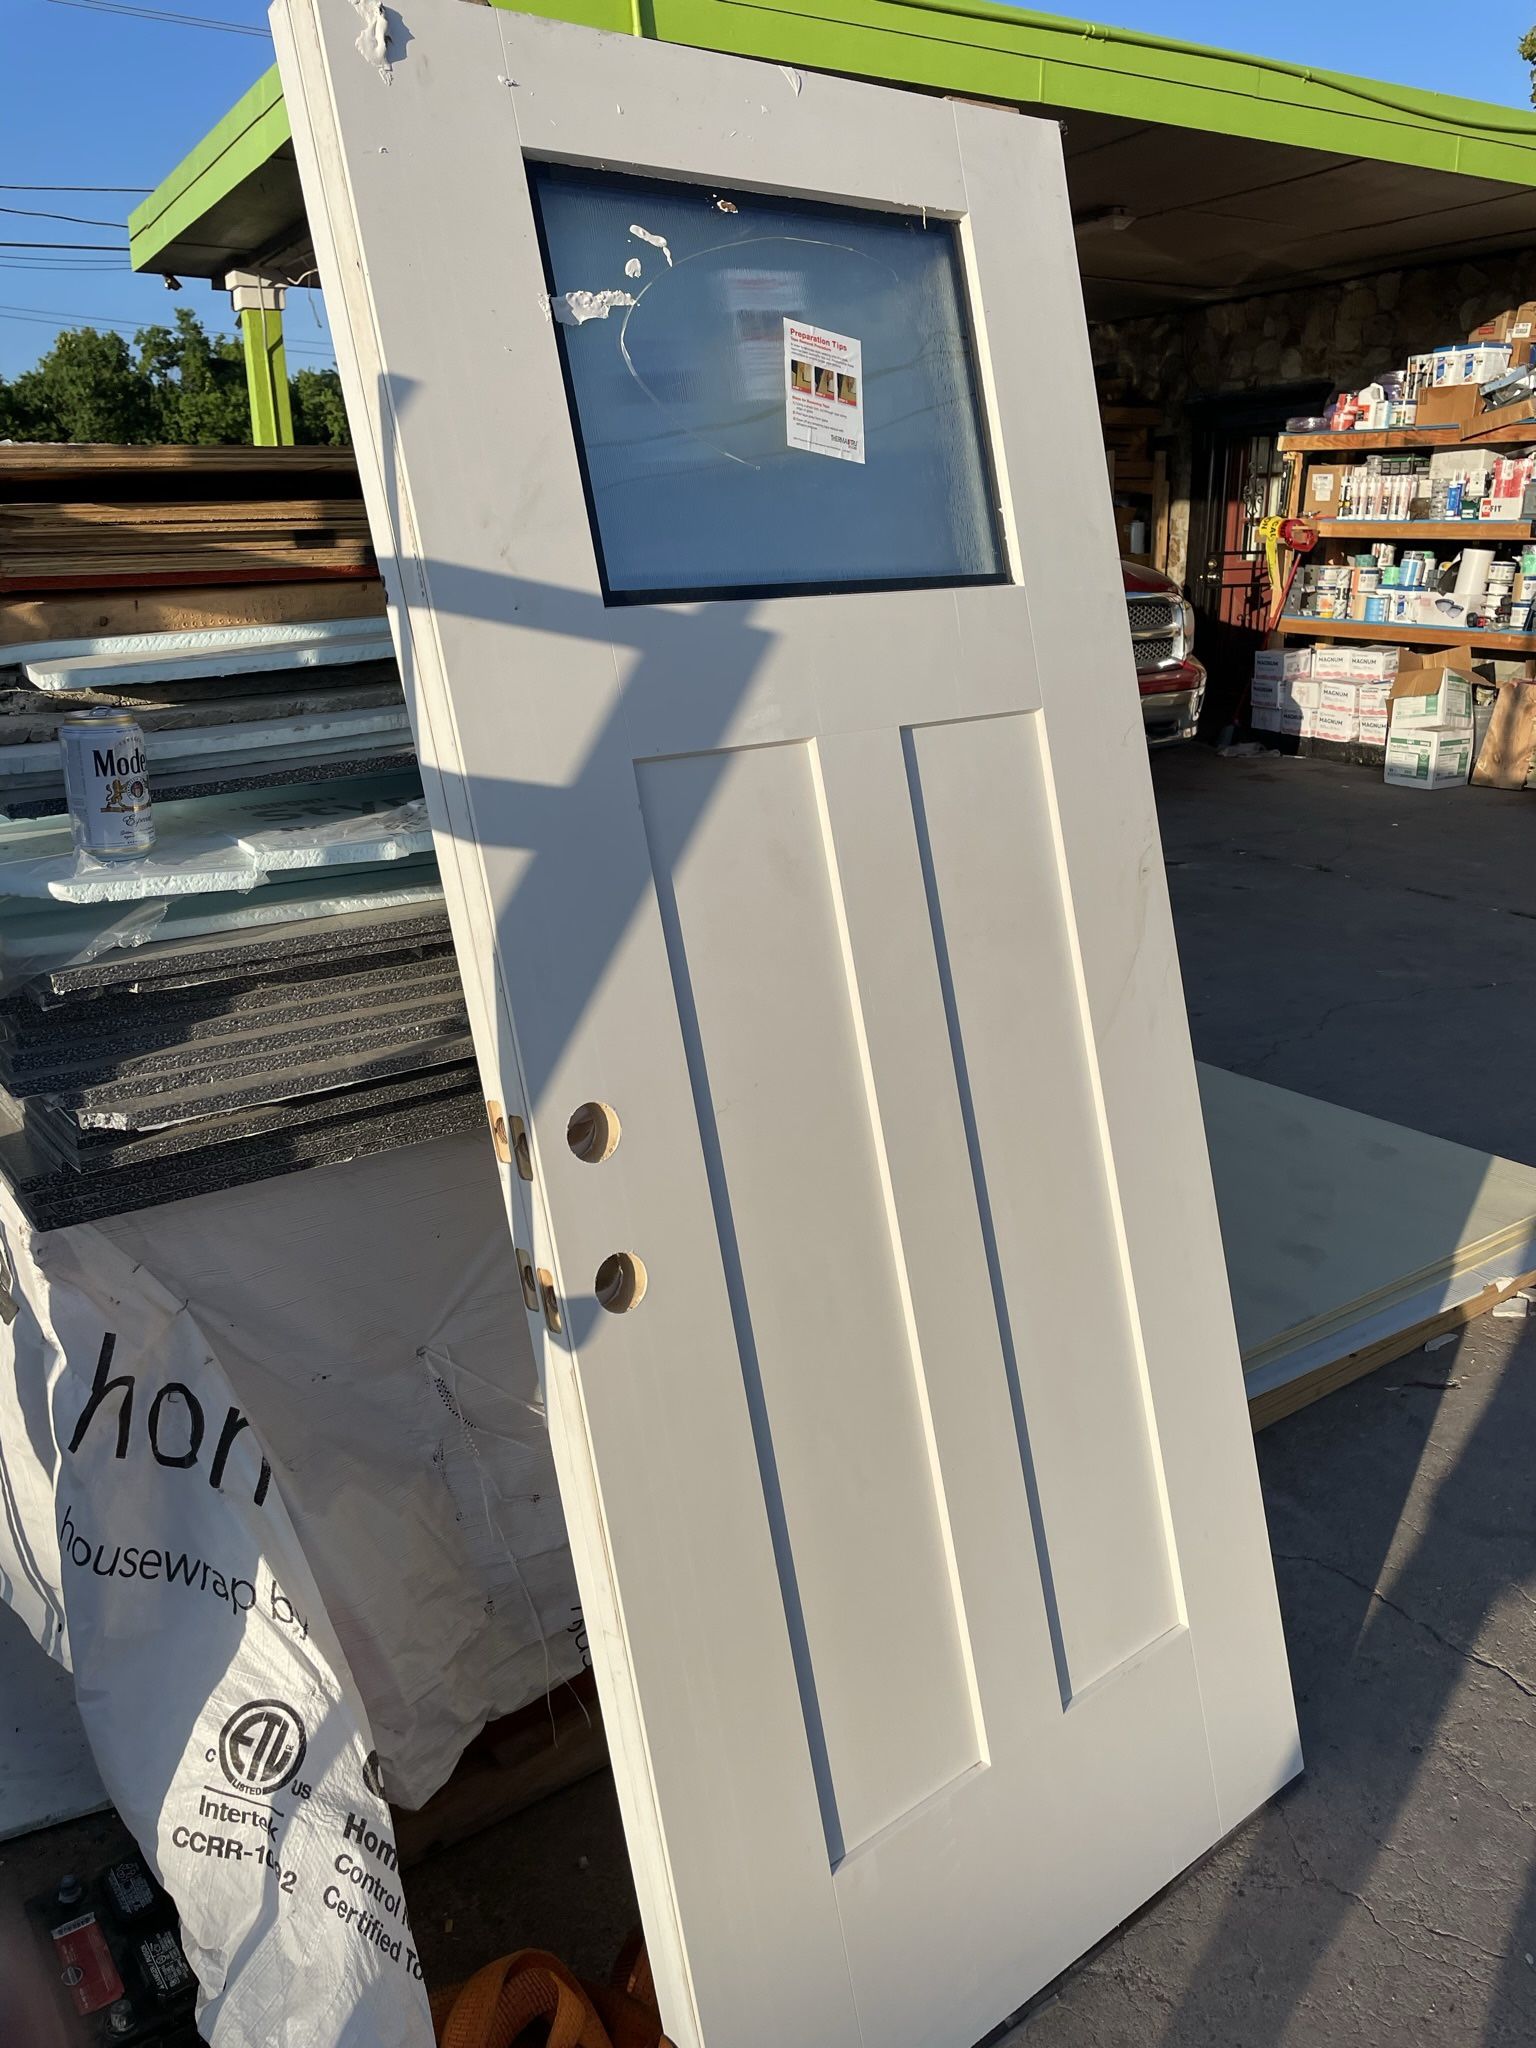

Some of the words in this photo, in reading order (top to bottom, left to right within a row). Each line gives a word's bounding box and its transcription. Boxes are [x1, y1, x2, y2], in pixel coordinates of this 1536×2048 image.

[790, 328, 831, 347] Preparation
[832, 340, 848, 351] Tips
[1323, 689, 1349, 697] MAGNUM
[1319, 717, 1343, 726] MAGNUM
[1361, 721, 1387, 729] MAGNUM
[60, 1505, 257, 1616] housewrap
[231, 1778, 263, 1796] LISTED
[291, 1779, 312, 1800] US
[199, 1795, 279, 1843] Intertek
[334, 1853, 401, 1918] Control
[323, 1885, 403, 1964] Certified
